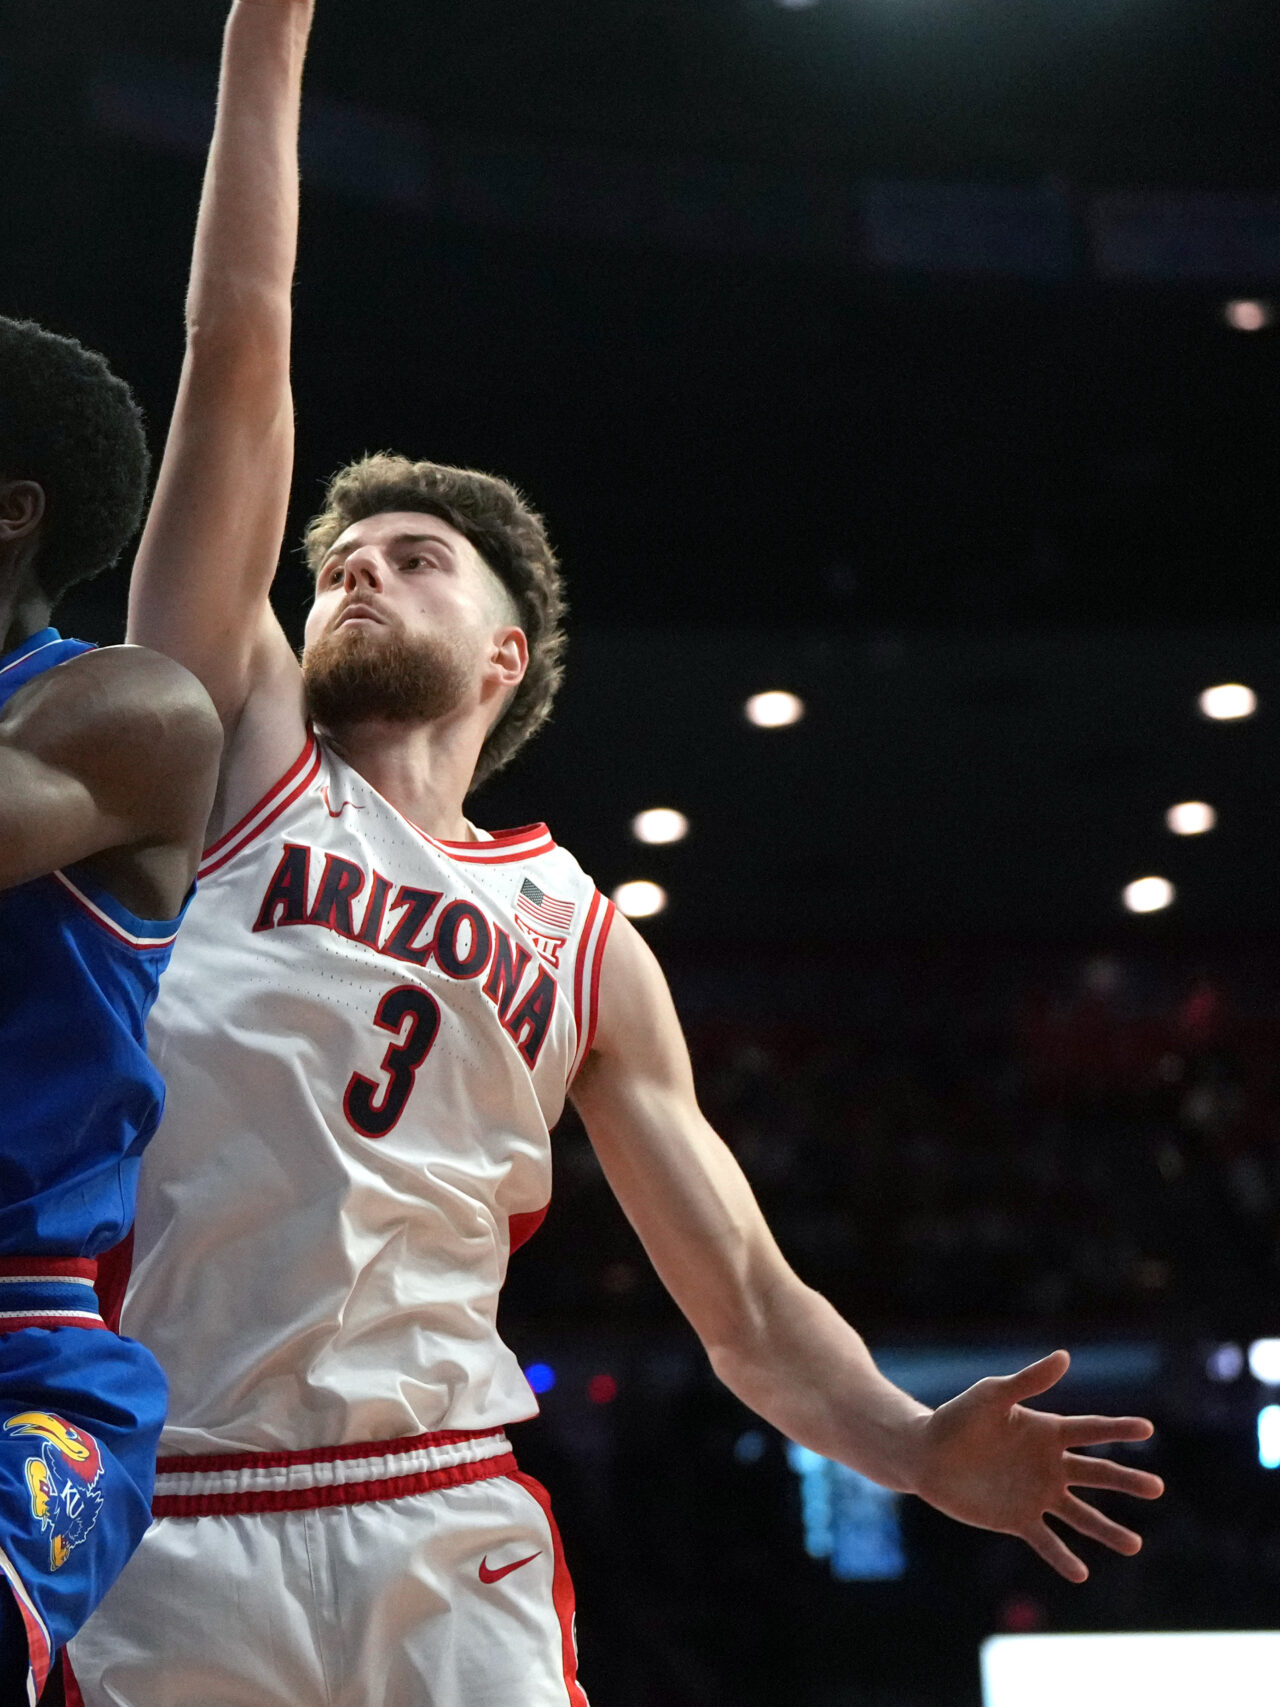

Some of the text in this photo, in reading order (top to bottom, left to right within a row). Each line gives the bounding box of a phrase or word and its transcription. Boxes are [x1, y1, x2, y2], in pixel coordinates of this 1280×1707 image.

[252, 843, 558, 1070] ARIZONA
[342, 984, 441, 1139] 3
[60, 1480, 85, 1519] KU
